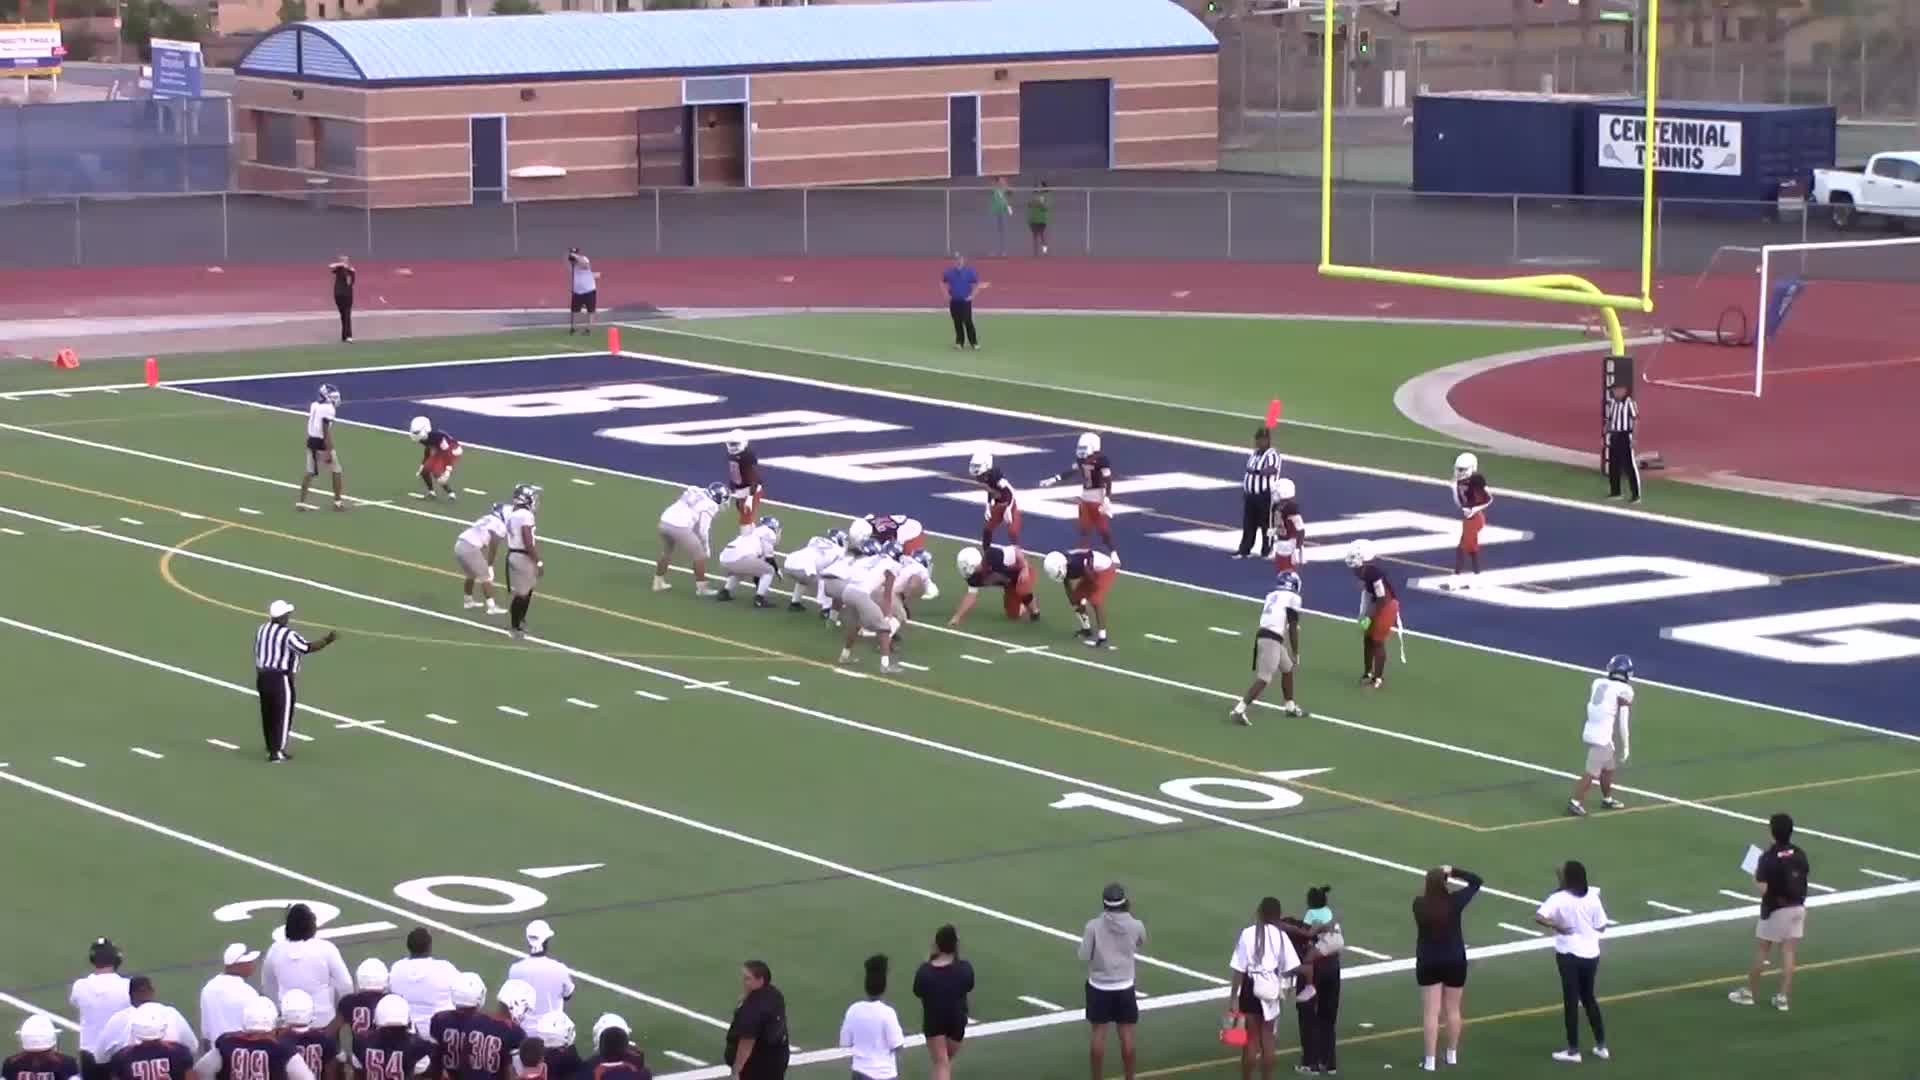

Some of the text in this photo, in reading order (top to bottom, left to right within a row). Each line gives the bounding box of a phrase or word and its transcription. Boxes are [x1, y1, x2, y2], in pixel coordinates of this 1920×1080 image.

[1634, 145, 1704, 169] TNNIS
[1048, 776, 1304, 825] 10
[212, 875, 549, 940] 20
